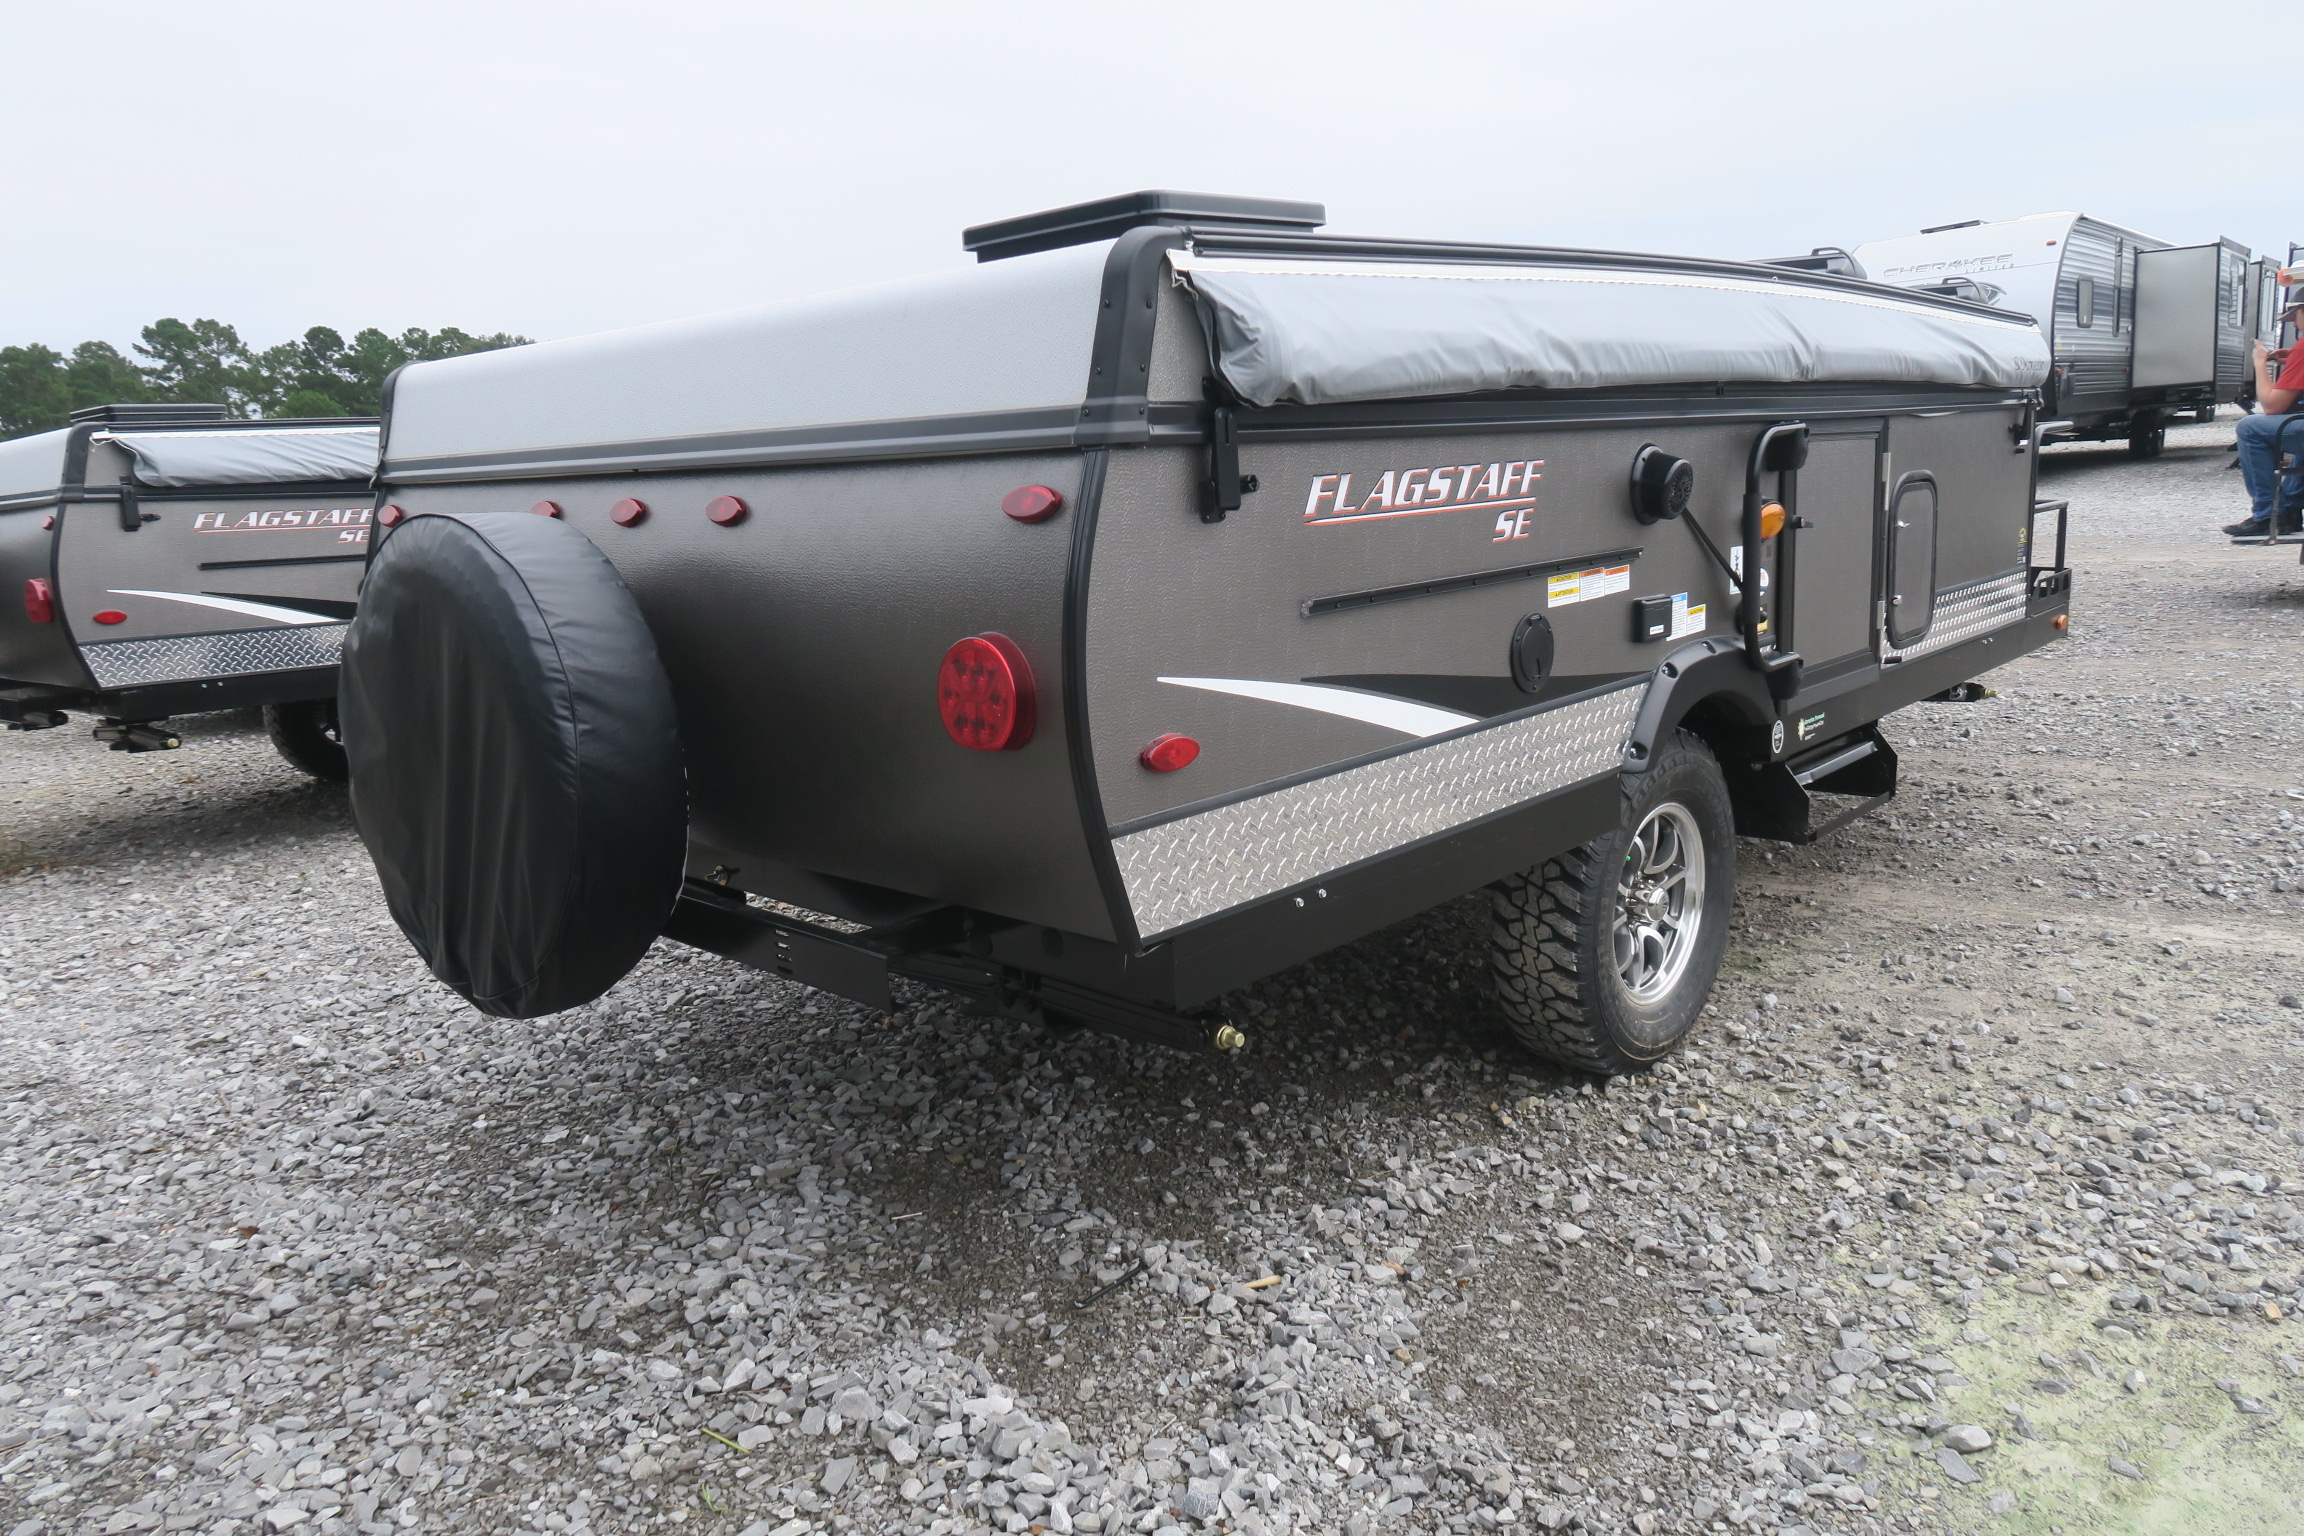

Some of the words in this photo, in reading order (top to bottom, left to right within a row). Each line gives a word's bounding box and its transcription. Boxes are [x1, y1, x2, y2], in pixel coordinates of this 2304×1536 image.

[1884, 254, 2013, 277] CHEROKEE
[1303, 459, 1545, 518] FLAGSTAFF
[193, 508, 374, 530] FLAGSTAFF
[1492, 507, 1535, 543] SE
[336, 529, 370, 544] SE
